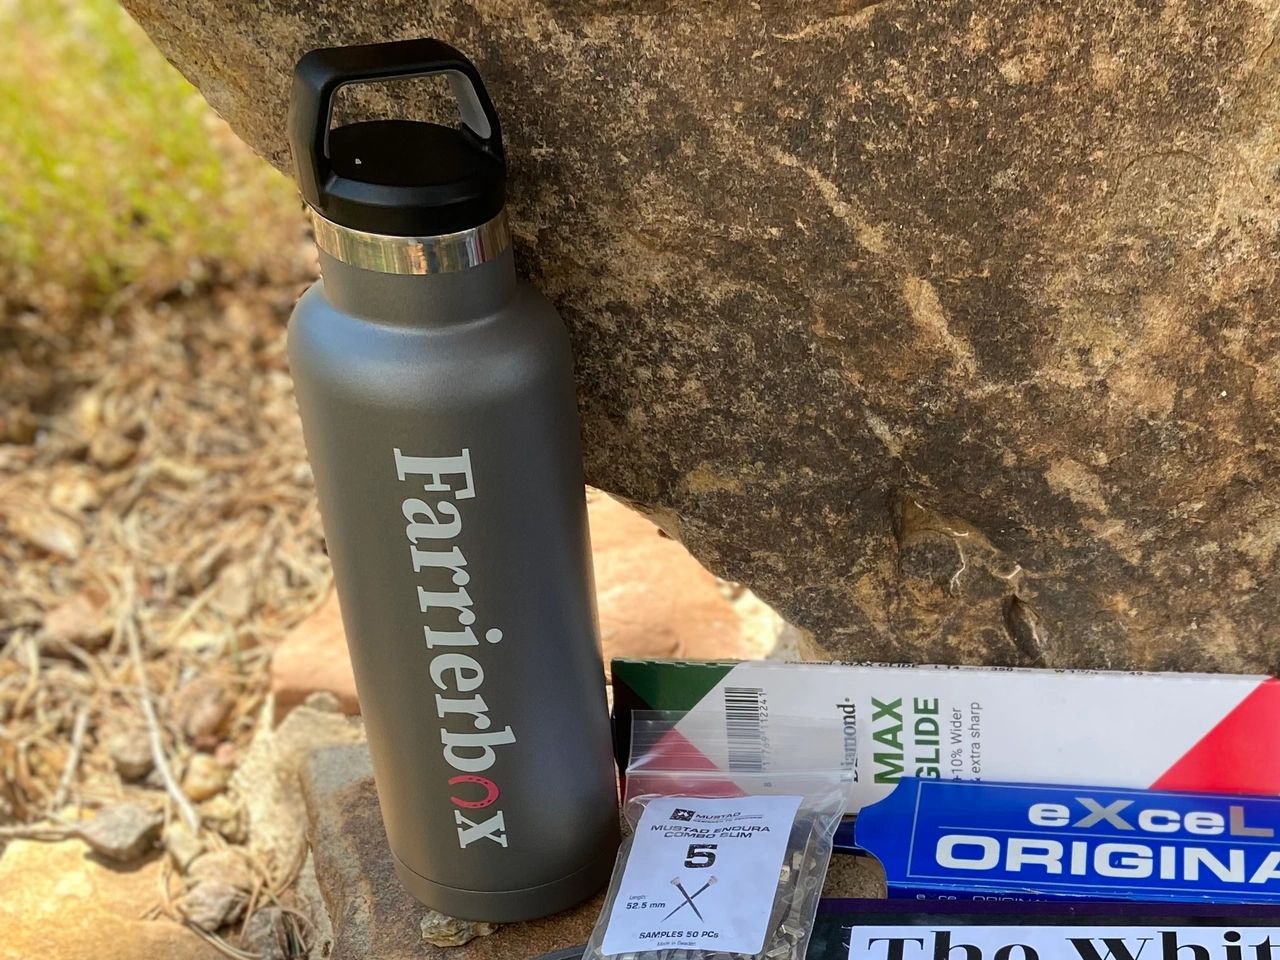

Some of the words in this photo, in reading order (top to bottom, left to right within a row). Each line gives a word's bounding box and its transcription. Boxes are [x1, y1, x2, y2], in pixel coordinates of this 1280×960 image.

[950, 707, 962, 745] Wider
[968, 702, 983, 738] sharp
[871, 696, 904, 784] MAX
[914, 698, 940, 779] GLIDE
[970, 742, 982, 774] extra
[650, 824, 710, 834] MUSTAD
[713, 825, 770, 833] ENDURA
[1028, 797, 1274, 838] eXceL
[664, 831, 715, 839] COMBO
[684, 844, 718, 868] 5
[626, 902, 647, 910] 52.5
[639, 931, 683, 939] SAMPLES
